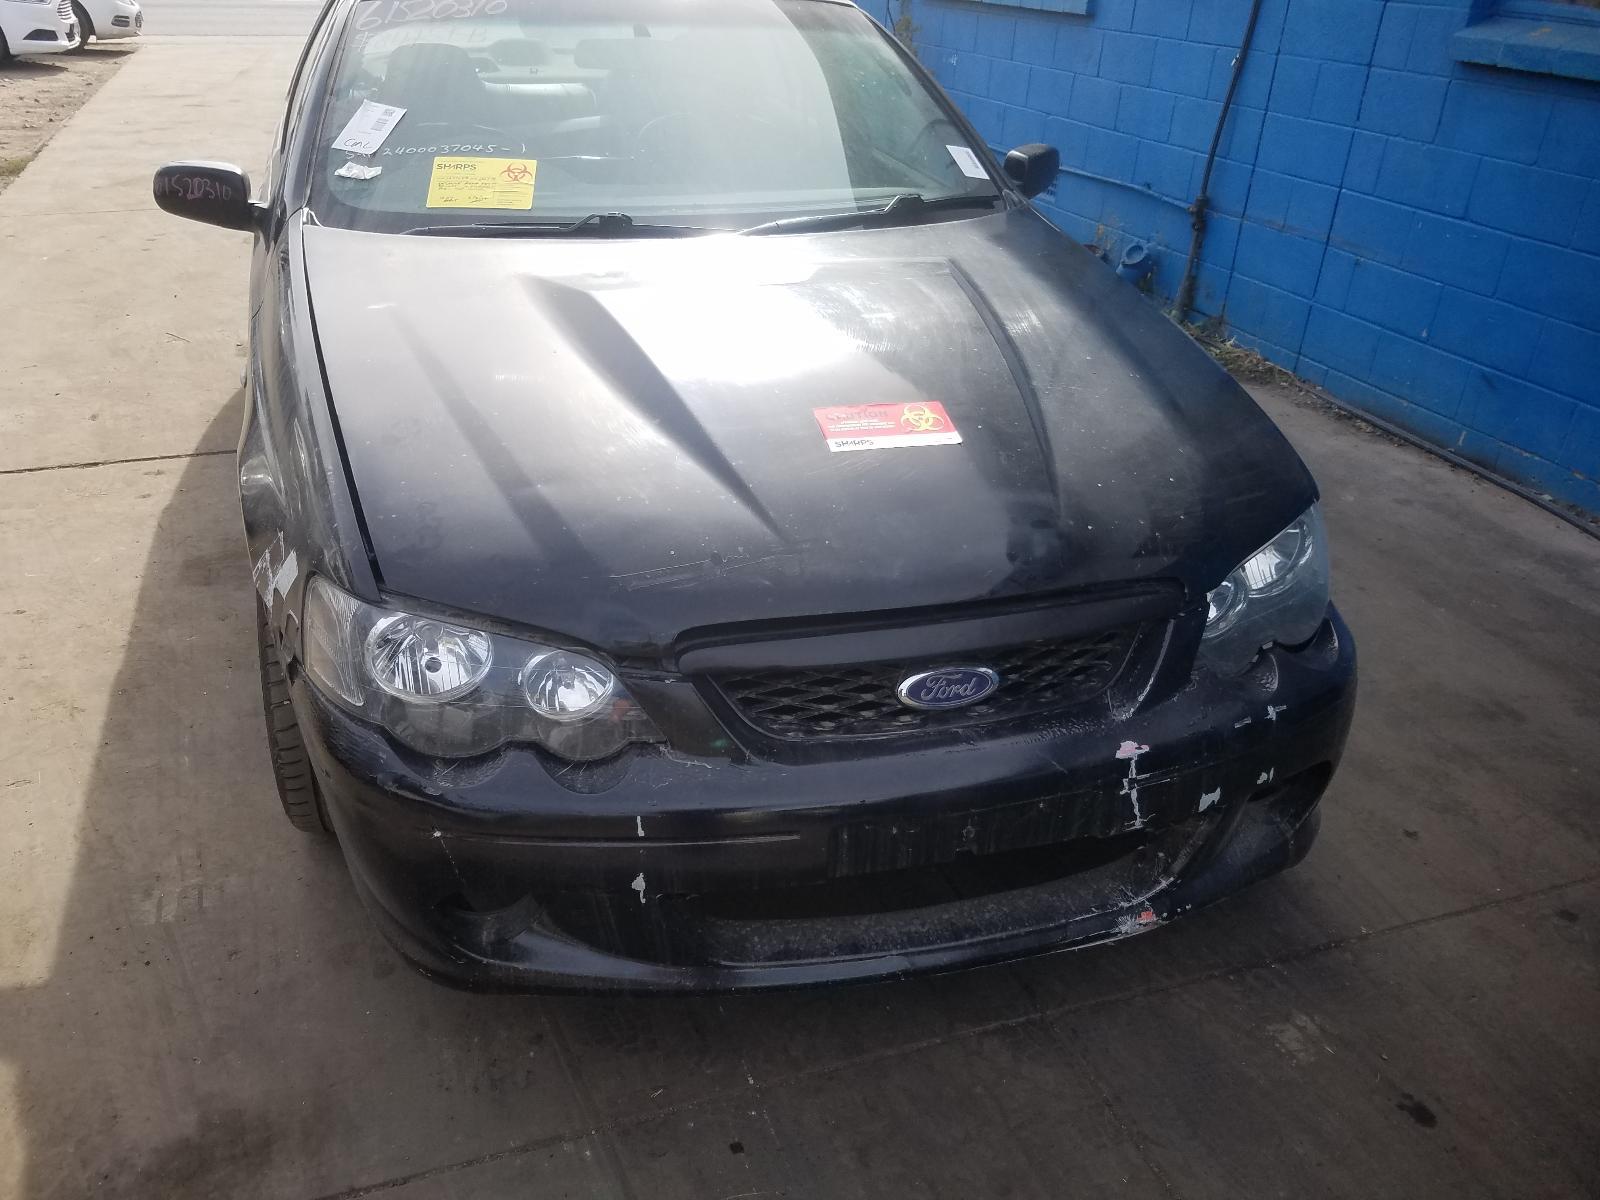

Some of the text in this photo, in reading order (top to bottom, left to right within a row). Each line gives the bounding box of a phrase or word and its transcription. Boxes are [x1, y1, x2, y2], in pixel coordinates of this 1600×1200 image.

[436, 163, 477, 171] SHARPS
[834, 439, 875, 449] SHARPS
[920, 673, 976, 701] Ford
